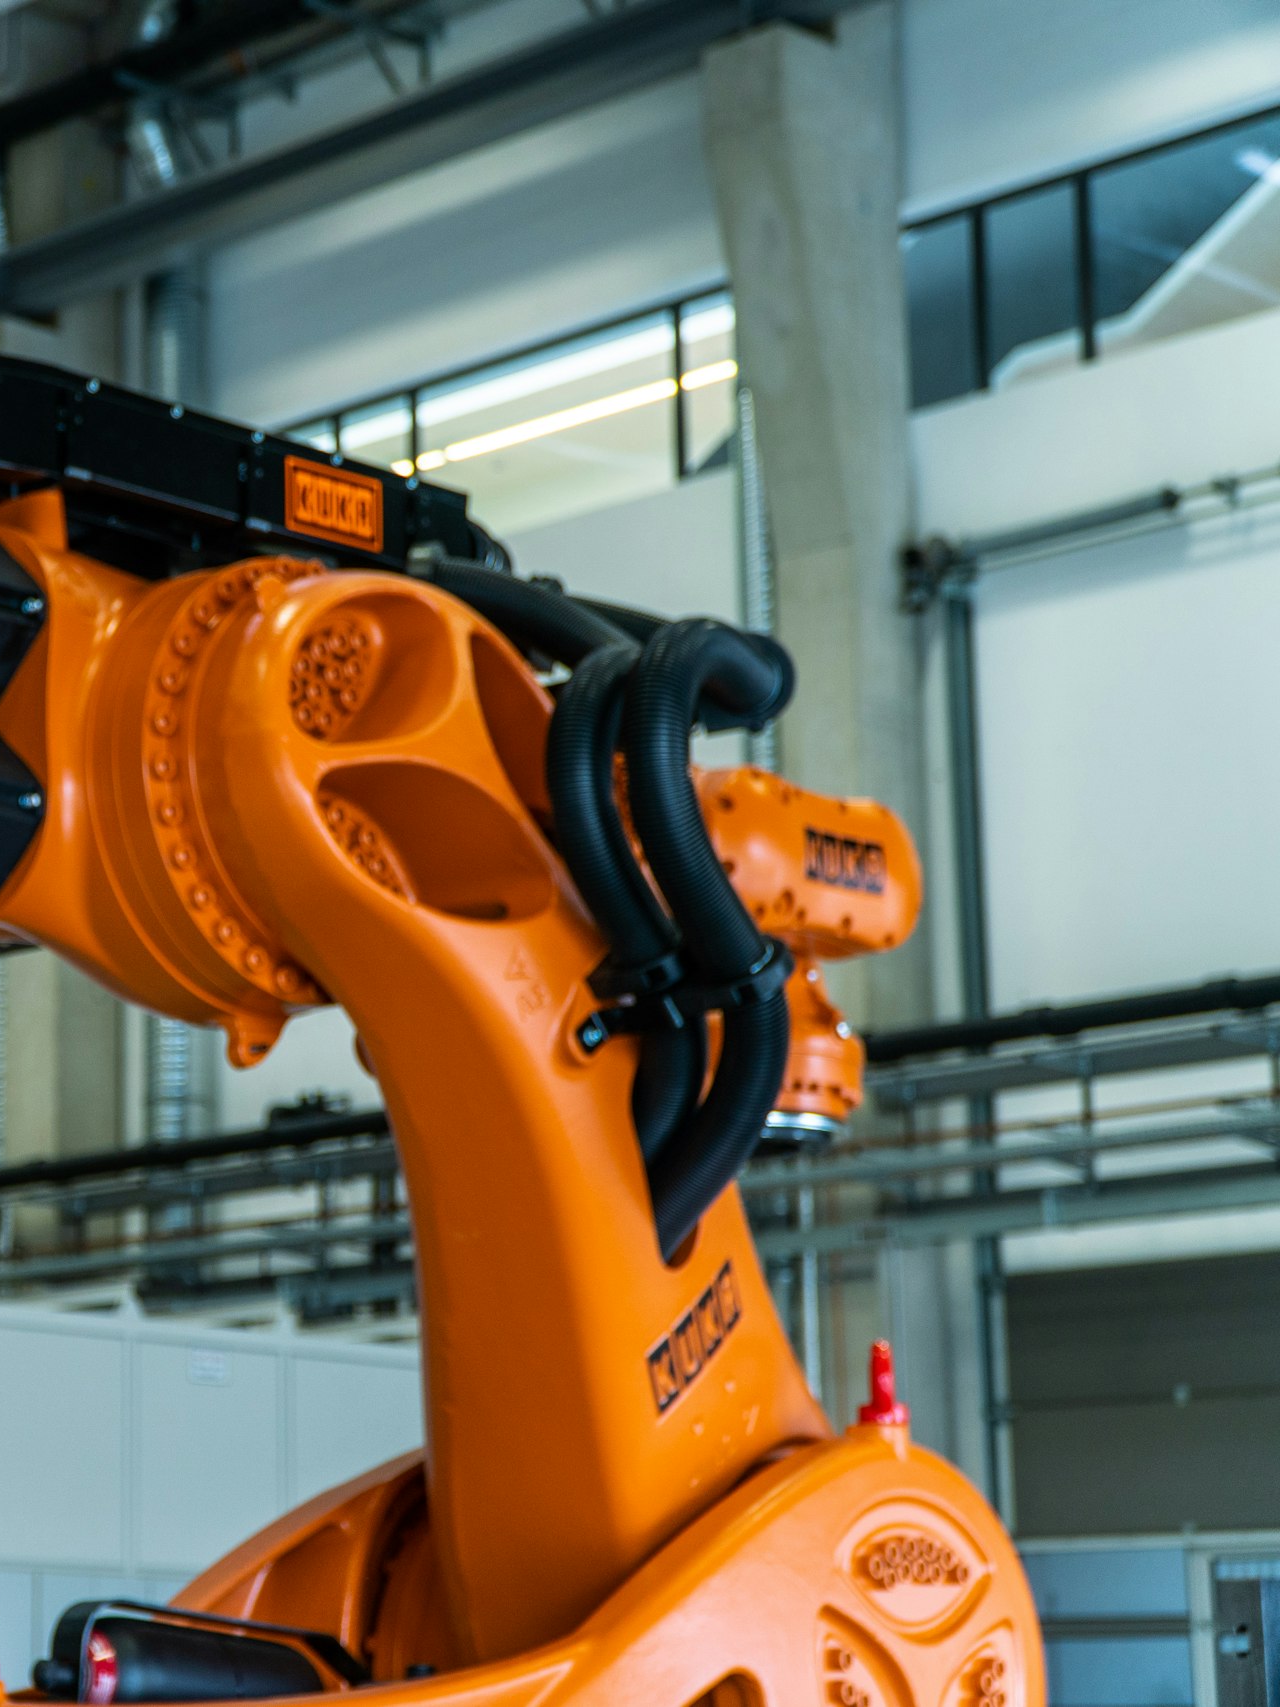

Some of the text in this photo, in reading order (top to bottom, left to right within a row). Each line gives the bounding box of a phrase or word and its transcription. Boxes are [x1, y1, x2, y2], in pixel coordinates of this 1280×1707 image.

[294, 468, 375, 541] KUKA
[804, 827, 885, 895] KUKA
[648, 1261, 741, 1413] KUKA
